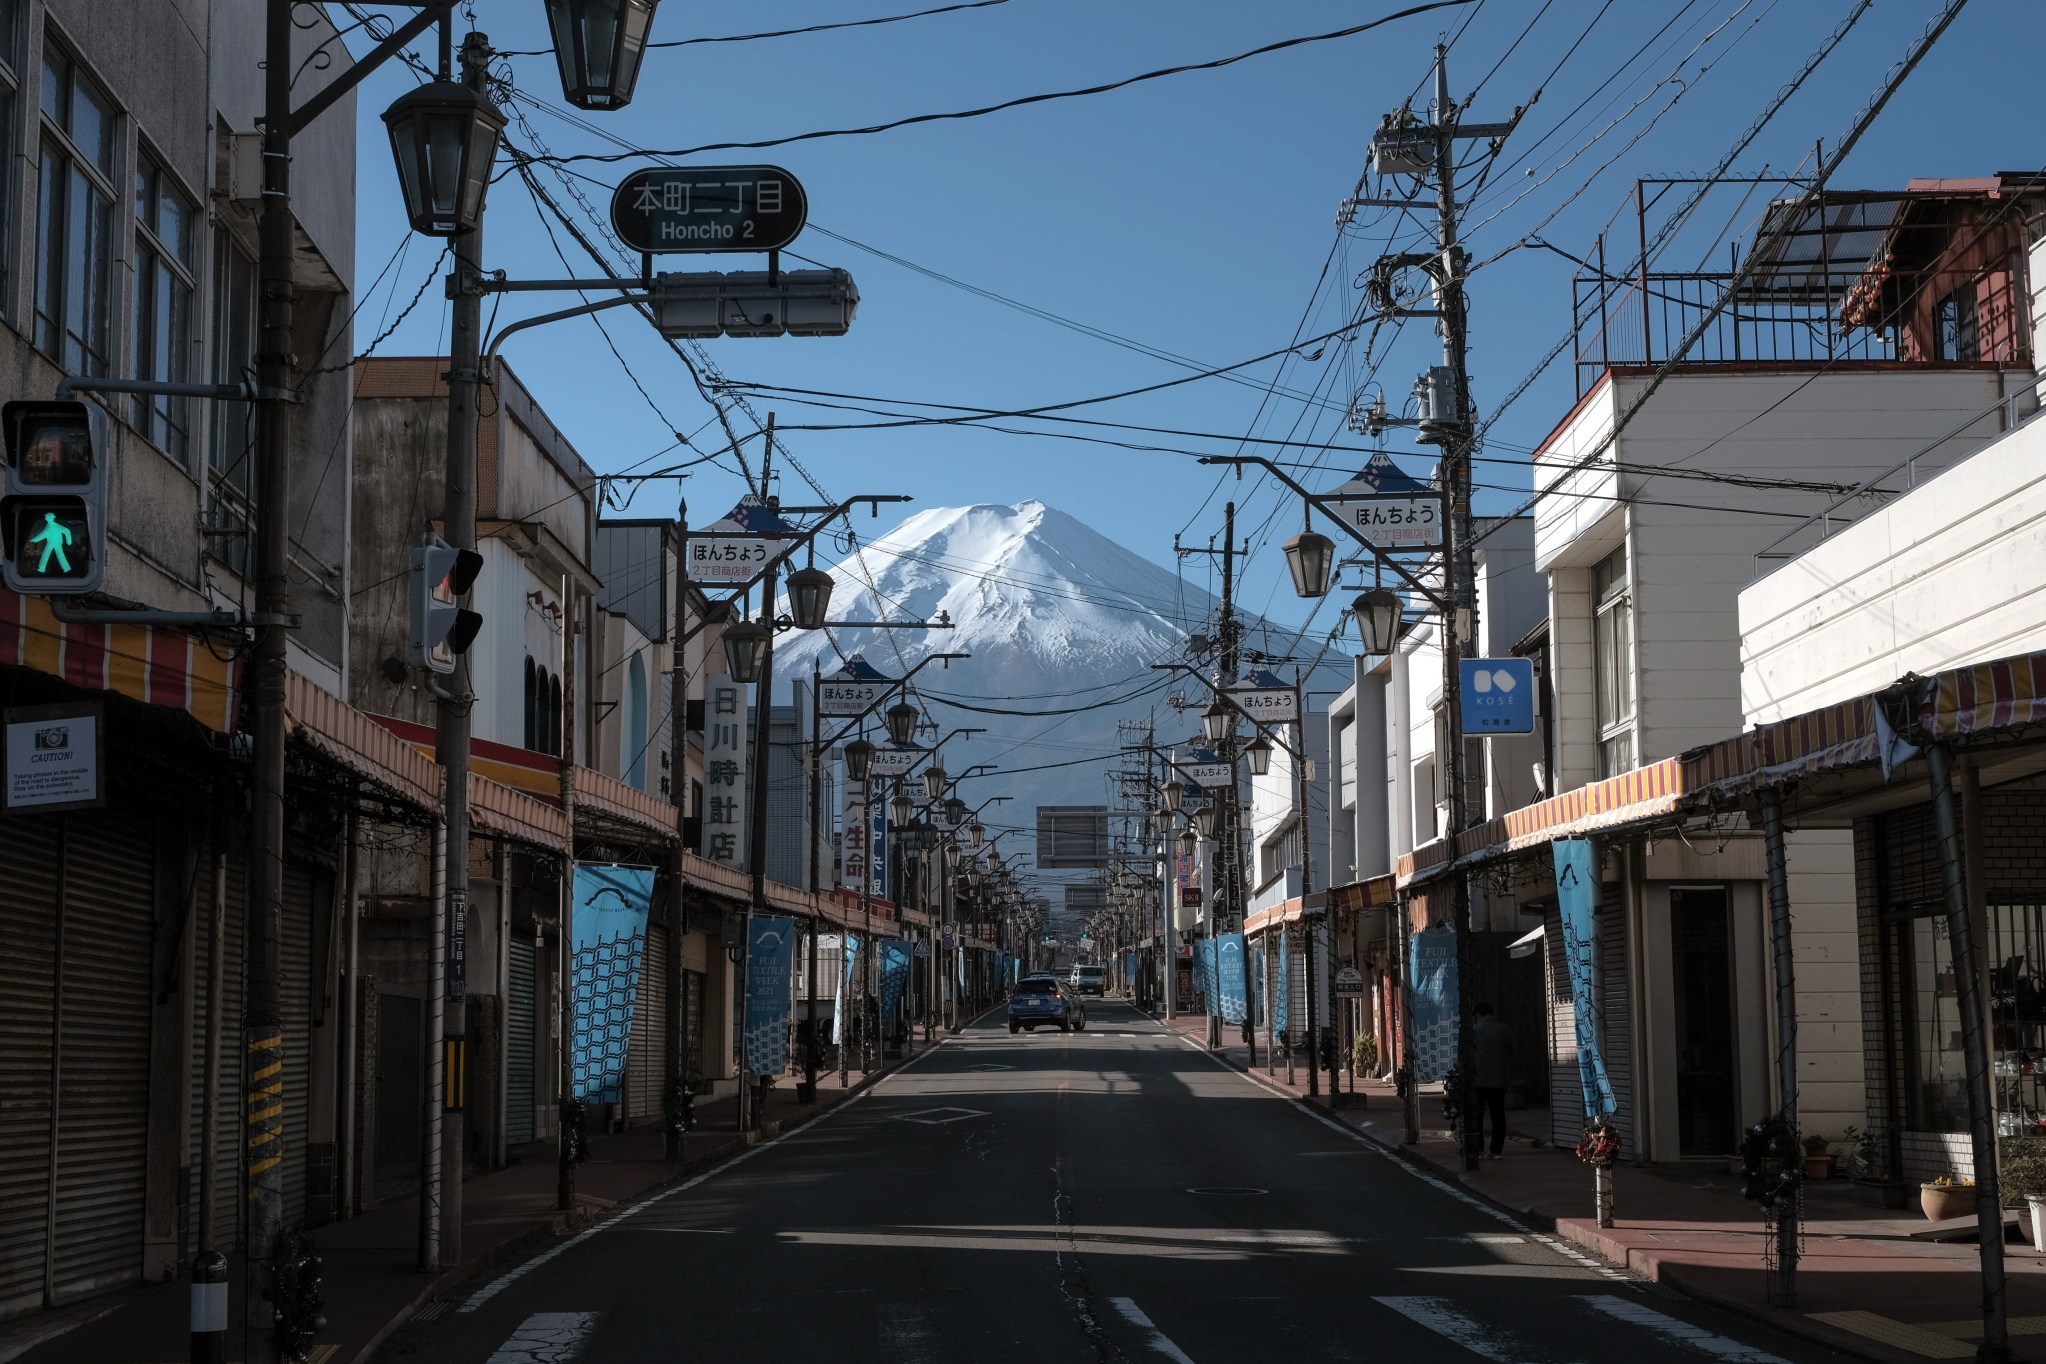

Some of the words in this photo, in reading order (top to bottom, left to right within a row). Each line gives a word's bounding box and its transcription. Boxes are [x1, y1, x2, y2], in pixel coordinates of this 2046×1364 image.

[632, 180, 782, 216] 本町二丁目
[661, 221, 734, 240] Honcho
[742, 220, 755, 239] 2
[1356, 505, 1434, 525] ほんちょう
[1372, 528, 1434, 541] 2丁目商店街
[693, 544, 766, 561] ほんちょう
[693, 566, 751, 576] 2丁目商店街
[824, 687, 874, 700] ほんちょう
[1244, 695, 1292, 707] ほんちょう
[1476, 694, 1515, 706] KOSÉ
[31, 751, 74, 763] CAUTION!
[873, 755, 912, 765] ほんちょう
[70, 767, 89, 775] middle
[709, 687, 738, 861] 日川時計店
[1193, 766, 1229, 778] ほんちょう
[1426, 947, 1447, 958] FUJI
[759, 956, 776, 966] FUJI
[753, 966, 786, 975] TEXTILE
[1420, 969, 1449, 978] WEEK
[755, 976, 779, 985] WEEK
[757, 986, 773, 995] 2021
